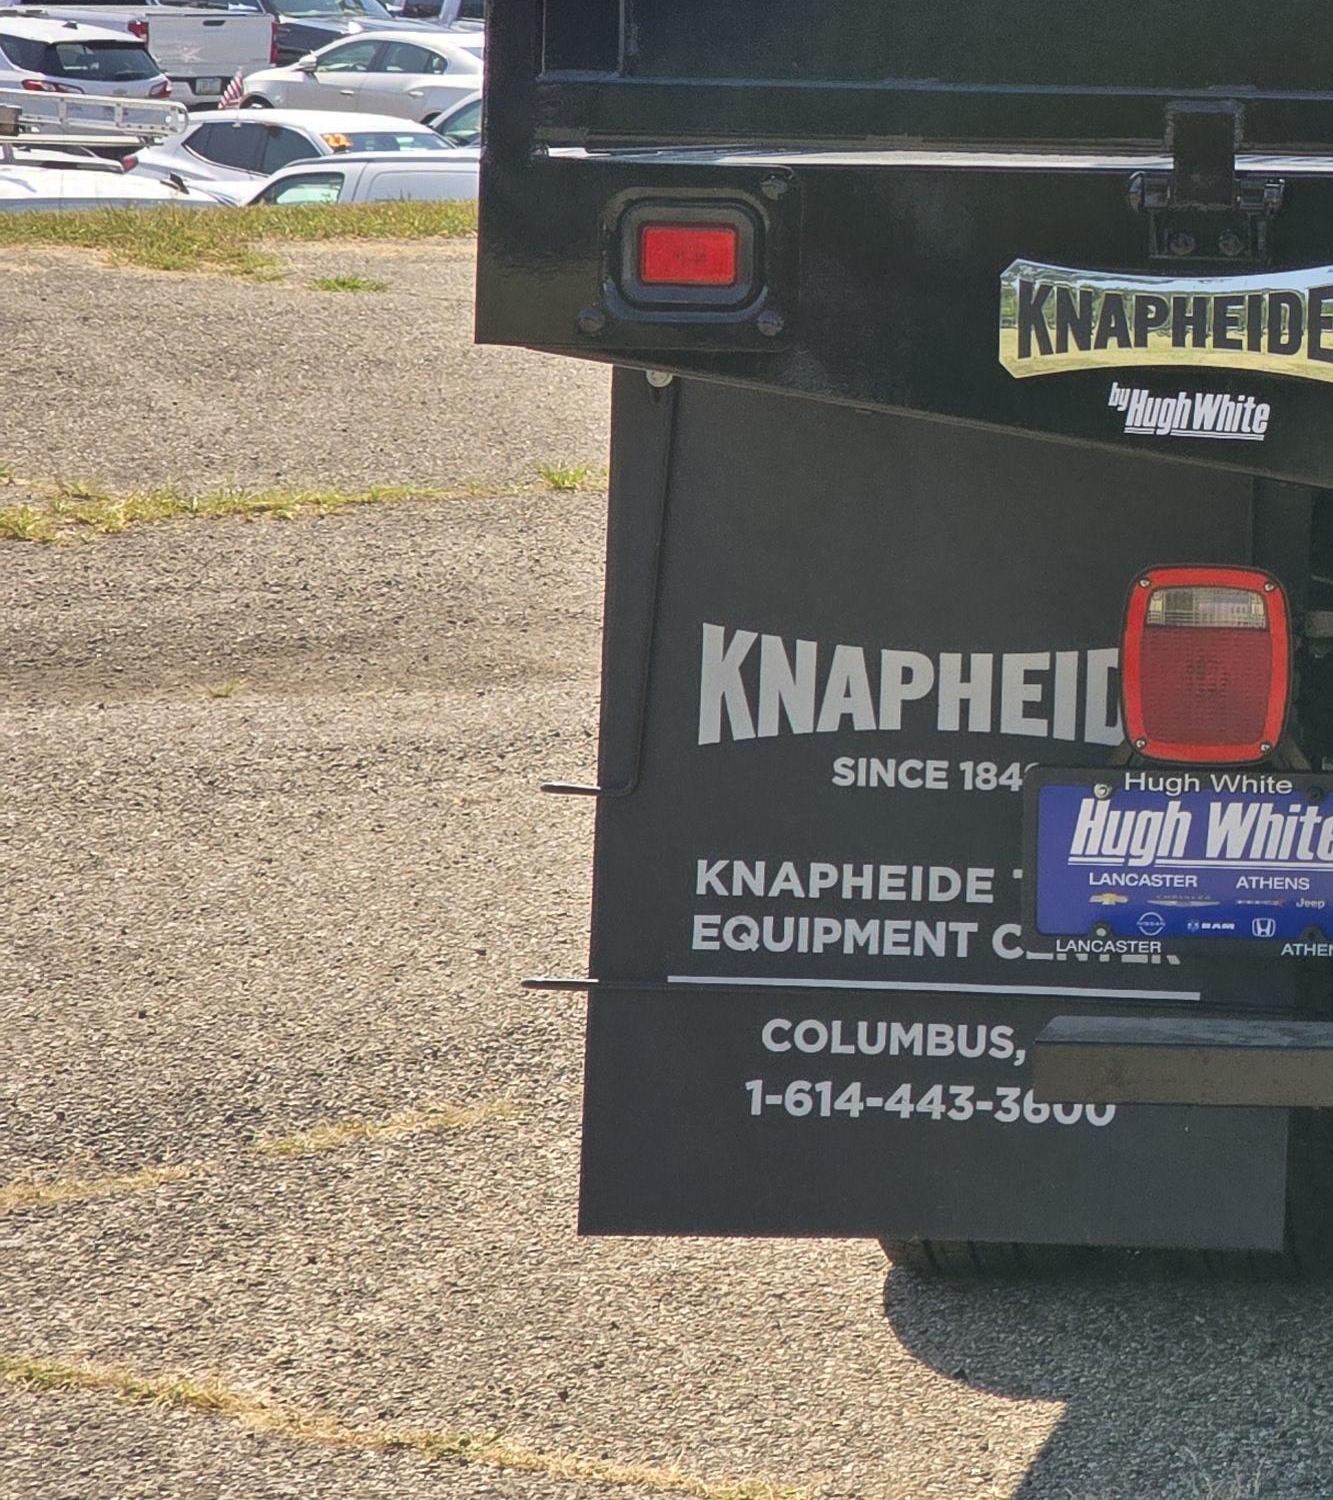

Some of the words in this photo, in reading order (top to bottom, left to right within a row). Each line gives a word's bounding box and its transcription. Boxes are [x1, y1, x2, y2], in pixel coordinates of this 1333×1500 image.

[1108, 382, 1131, 412] by
[1125, 388, 1192, 436] Hugh
[1191, 393, 1271, 435] White
[698, 622, 1124, 747] KNAPHEID
[832, 756, 949, 791] SINCE
[959, 761, 1040, 792] 184
[1125, 772, 1200, 797] Hugh
[1211, 774, 1293, 795] White
[1069, 798, 1193, 867] Hugh
[695, 858, 995, 905] KNAPHEIDE
[1089, 872, 1199, 889] LANCASTER
[1236, 876, 1311, 891] ATHENS
[1296, 897, 1326, 910] Jeep
[692, 913, 979, 959] EQUIPMENT
[1056, 939, 1162, 954] LANCASTER
[761, 1018, 1027, 1066] COLUMBUS,
